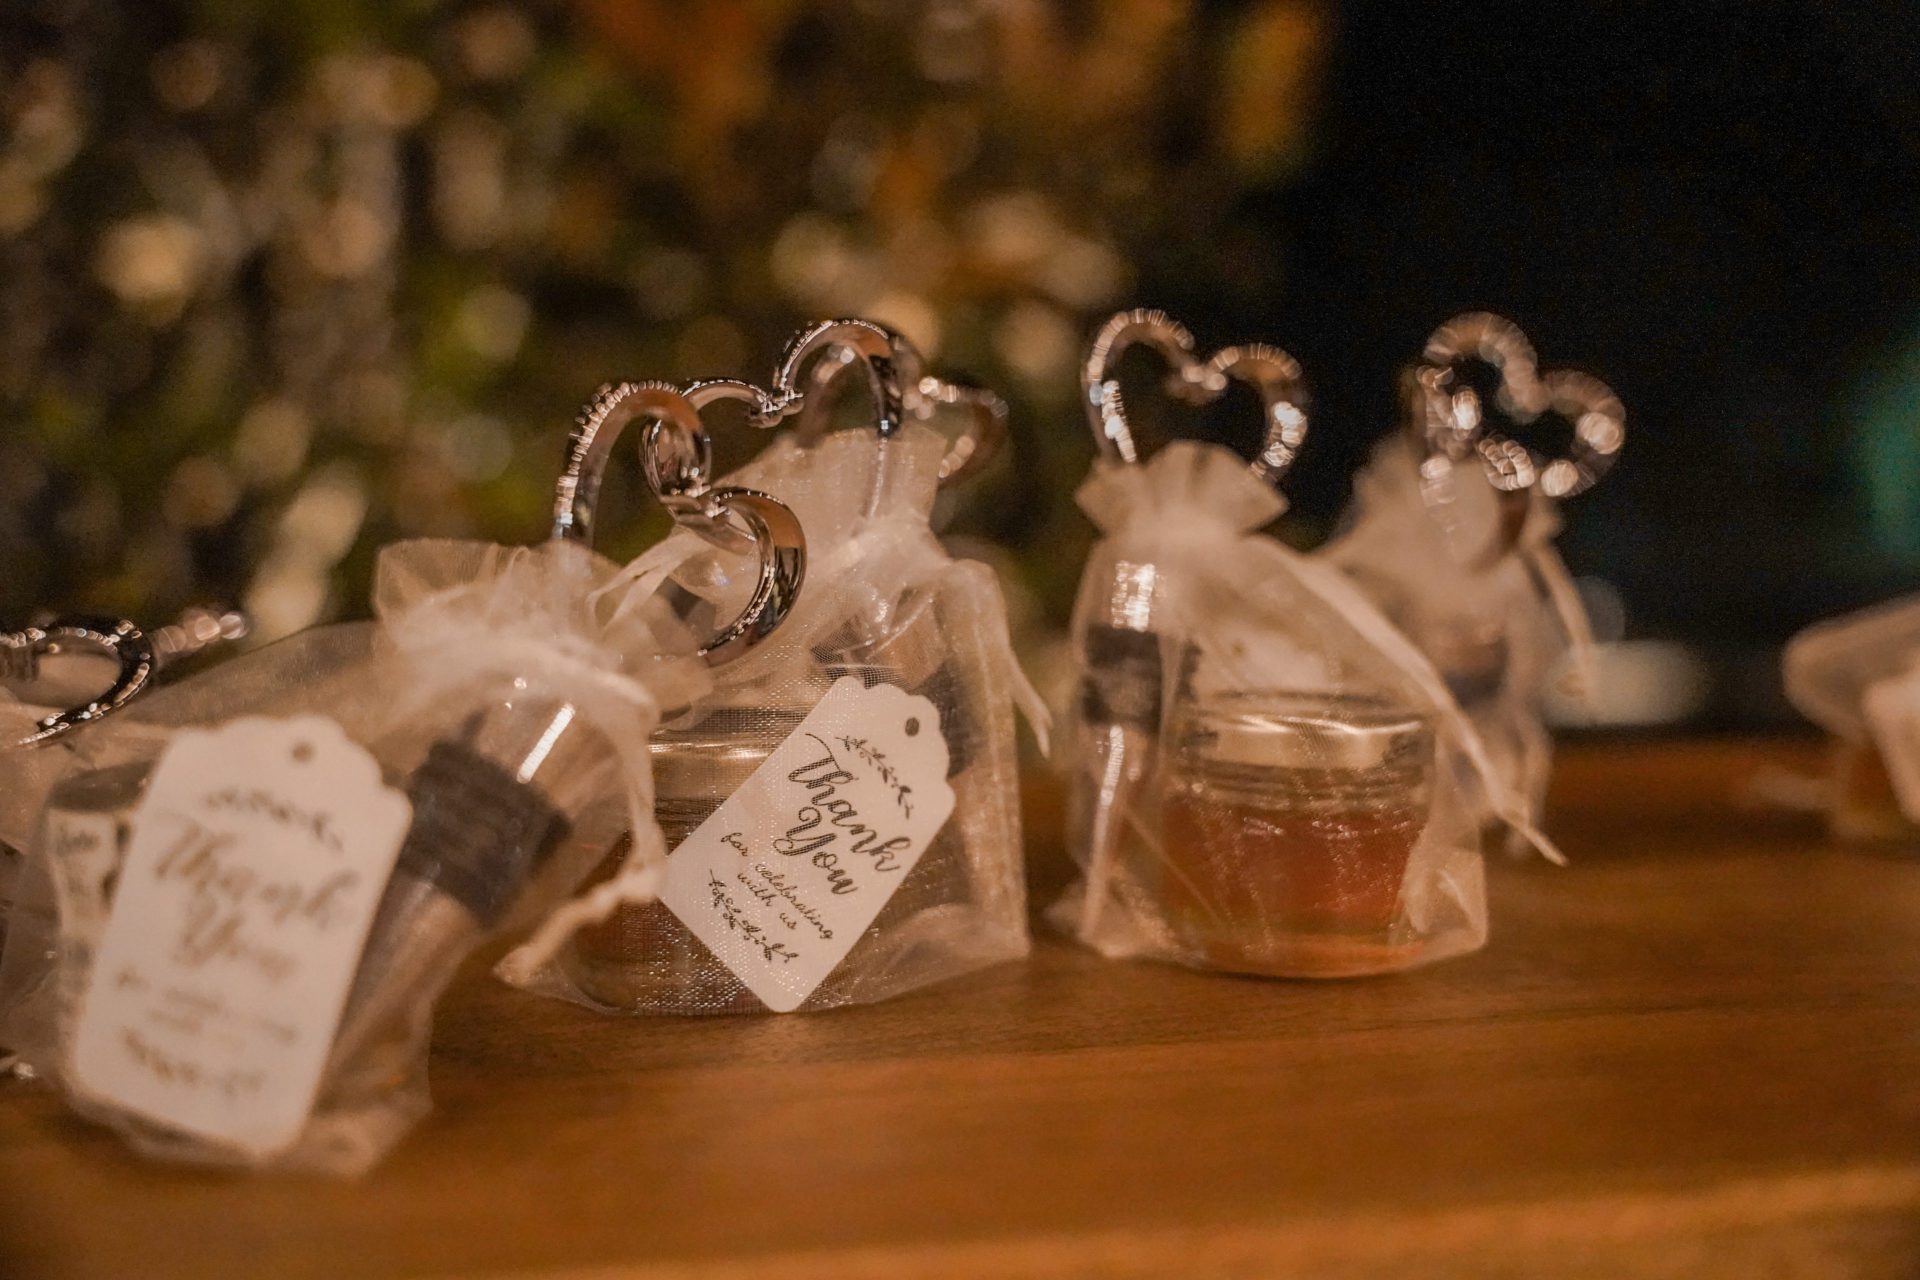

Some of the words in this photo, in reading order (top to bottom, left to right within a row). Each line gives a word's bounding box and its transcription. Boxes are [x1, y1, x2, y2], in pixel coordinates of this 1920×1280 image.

[773, 806, 859, 895] You
[788, 733, 911, 872] Thank
[720, 832, 749, 857] for
[755, 863, 833, 939] celebrating
[737, 872, 777, 906] with
[779, 912, 798, 930] us
